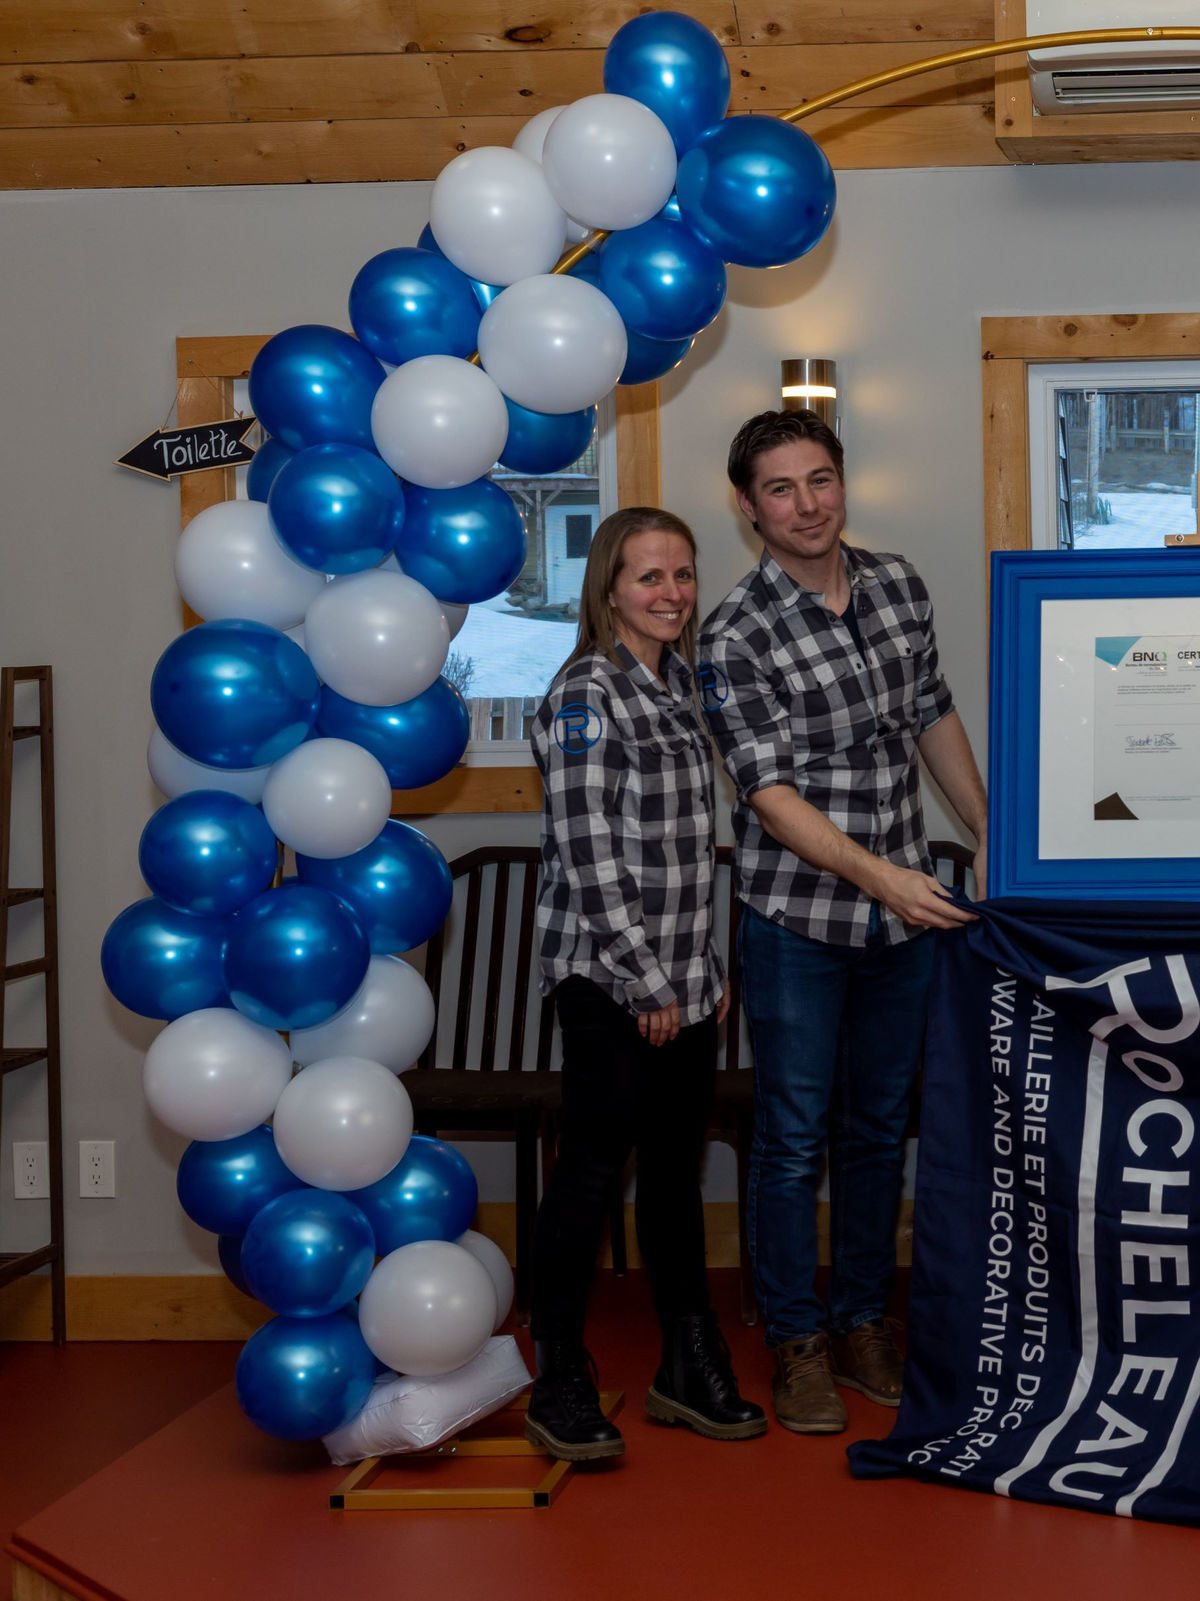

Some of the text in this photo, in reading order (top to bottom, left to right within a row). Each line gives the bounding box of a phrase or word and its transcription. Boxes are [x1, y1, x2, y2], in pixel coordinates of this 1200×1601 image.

[154, 429, 242, 469] Toilette
[1023, 994, 1056, 1144] AILLERIE
[907, 966, 1017, 1465] WARE AND DECORATIVE PROUC
[1024, 1153, 1046, 1195] ET
[1021, 1201, 1049, 1364] PRODUITS
